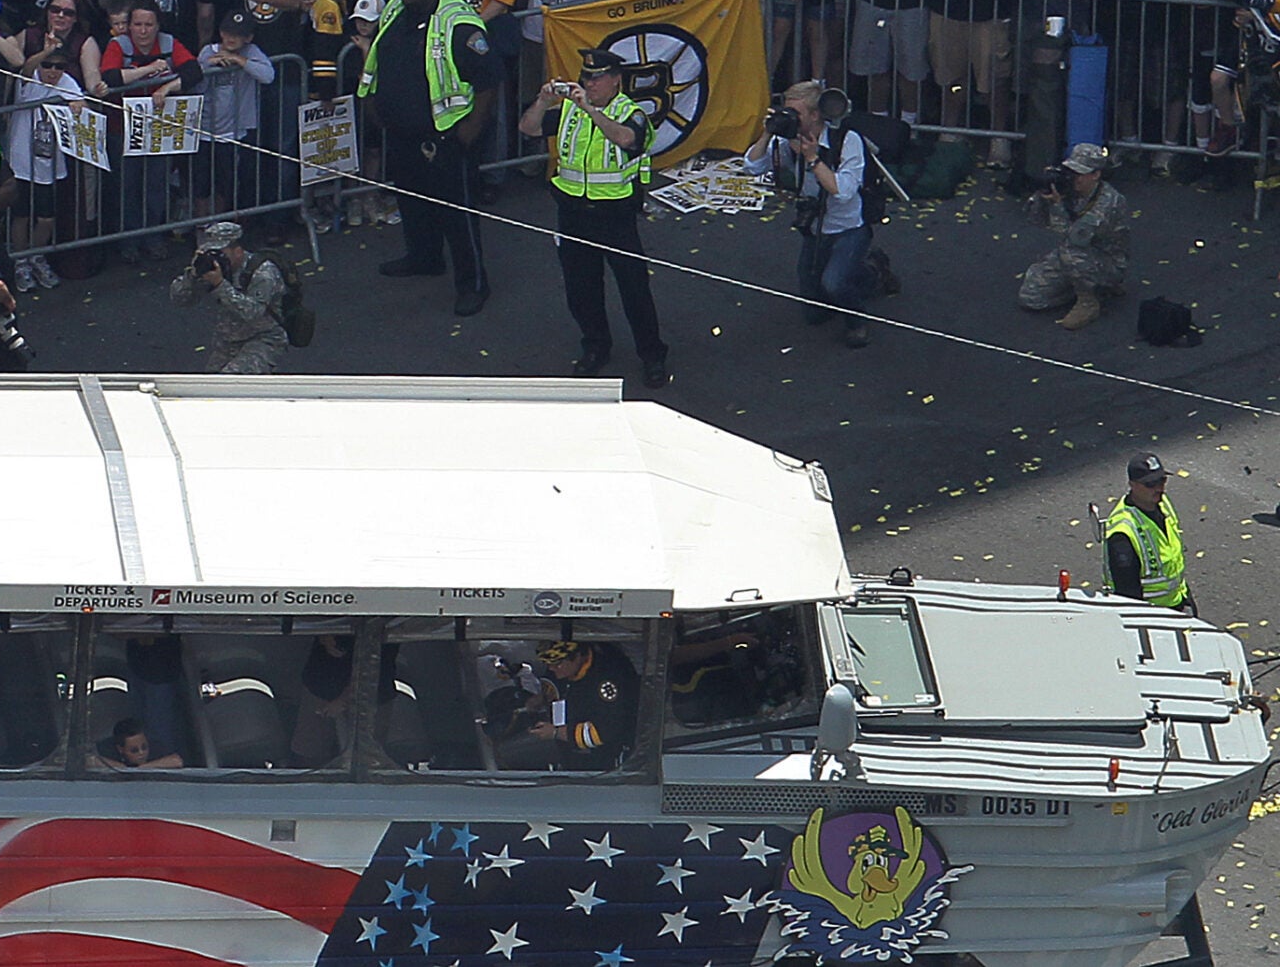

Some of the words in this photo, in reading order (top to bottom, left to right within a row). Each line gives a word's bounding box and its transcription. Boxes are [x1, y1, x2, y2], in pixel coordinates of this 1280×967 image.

[607, 8, 626, 18] GO
[303, 107, 335, 123] WEEI
[130, 114, 143, 150] WEEI
[64, 586, 117, 595] TICKETS
[124, 586, 133, 595] &
[452, 588, 505, 598] TICKETS
[176, 590, 254, 604] Museum
[260, 590, 278, 604] of
[569, 596, 584, 604] New
[586, 596, 613, 605] England
[54, 597, 143, 608] DEPARTURES
[569, 604, 601, 612] Aquarium
